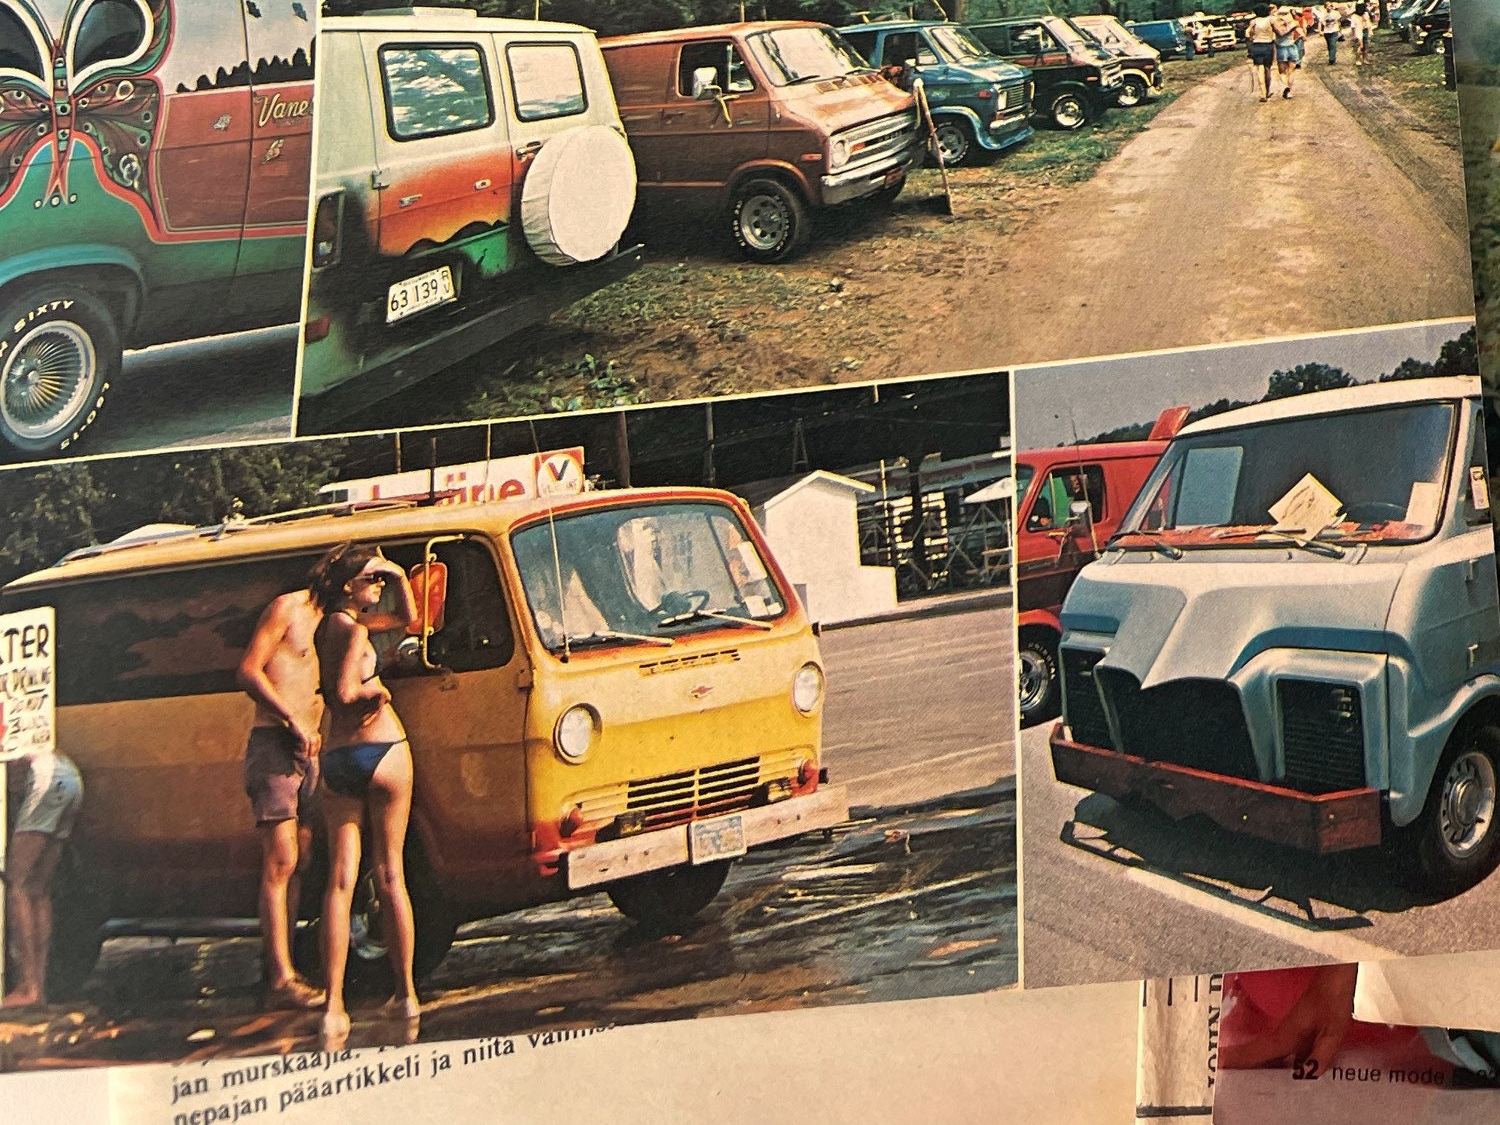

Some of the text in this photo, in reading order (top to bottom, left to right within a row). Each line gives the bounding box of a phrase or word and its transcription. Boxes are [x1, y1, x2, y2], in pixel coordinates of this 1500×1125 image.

[414, 278, 439, 302] 139
[278, 1056, 422, 1113] pääartikkeli
[429, 1050, 453, 1080] ja
[1292, 1059, 1319, 1081] 52
[1331, 1065, 1382, 1082] neue
[1388, 1068, 1445, 1086] mode
[171, 1075, 208, 1104] jan
